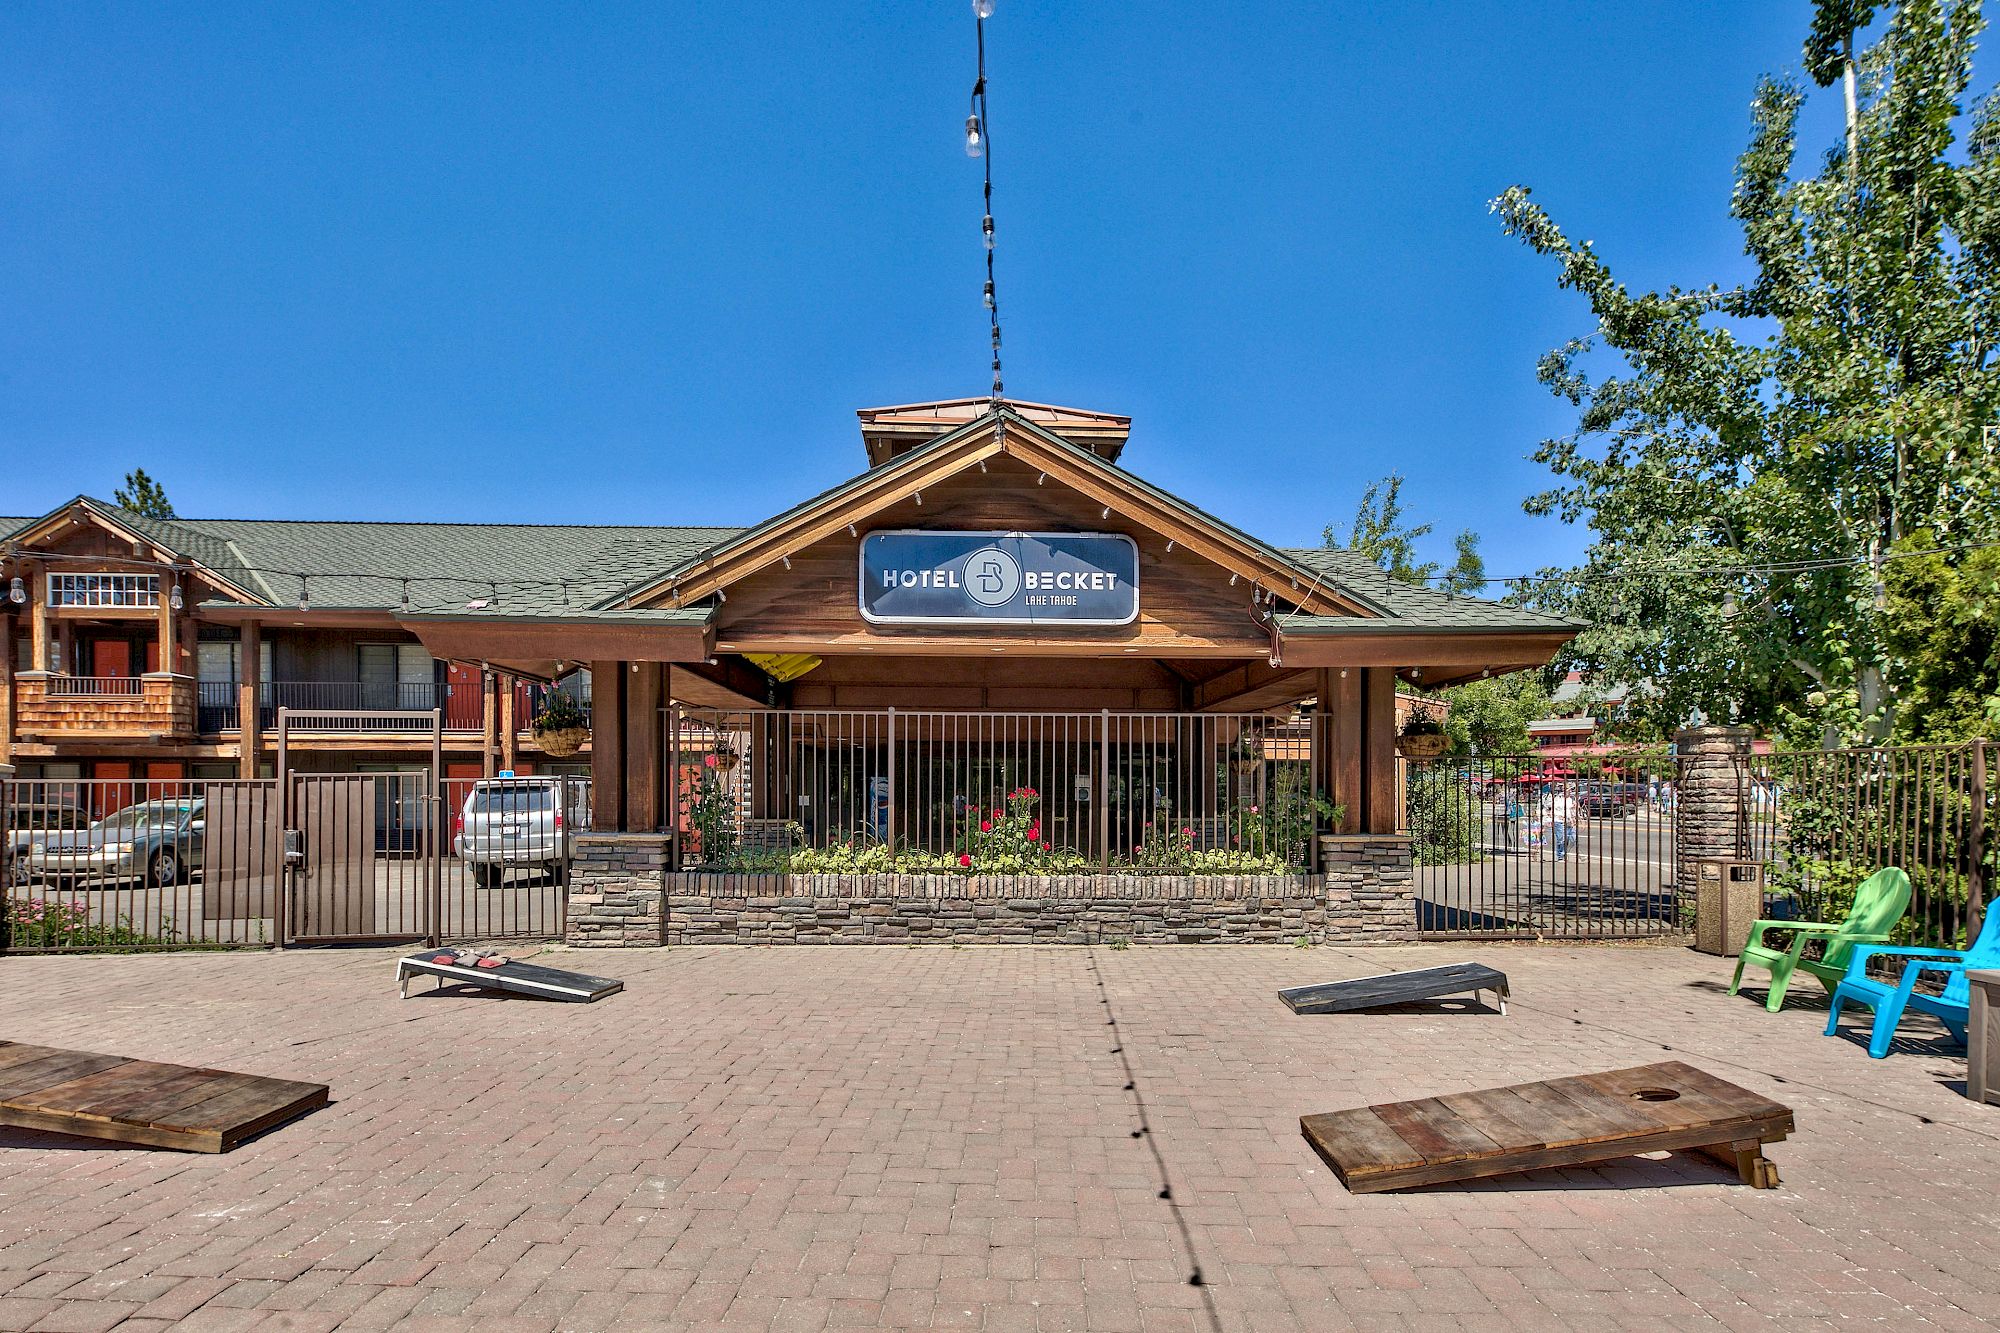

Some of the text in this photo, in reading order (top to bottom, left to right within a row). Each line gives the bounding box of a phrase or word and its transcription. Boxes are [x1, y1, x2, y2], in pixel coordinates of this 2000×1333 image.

[883, 569, 960, 588] HOTEL
[1025, 571, 1117, 590] BECKET
[1025, 595, 1077, 606] LAKE TAHOE
